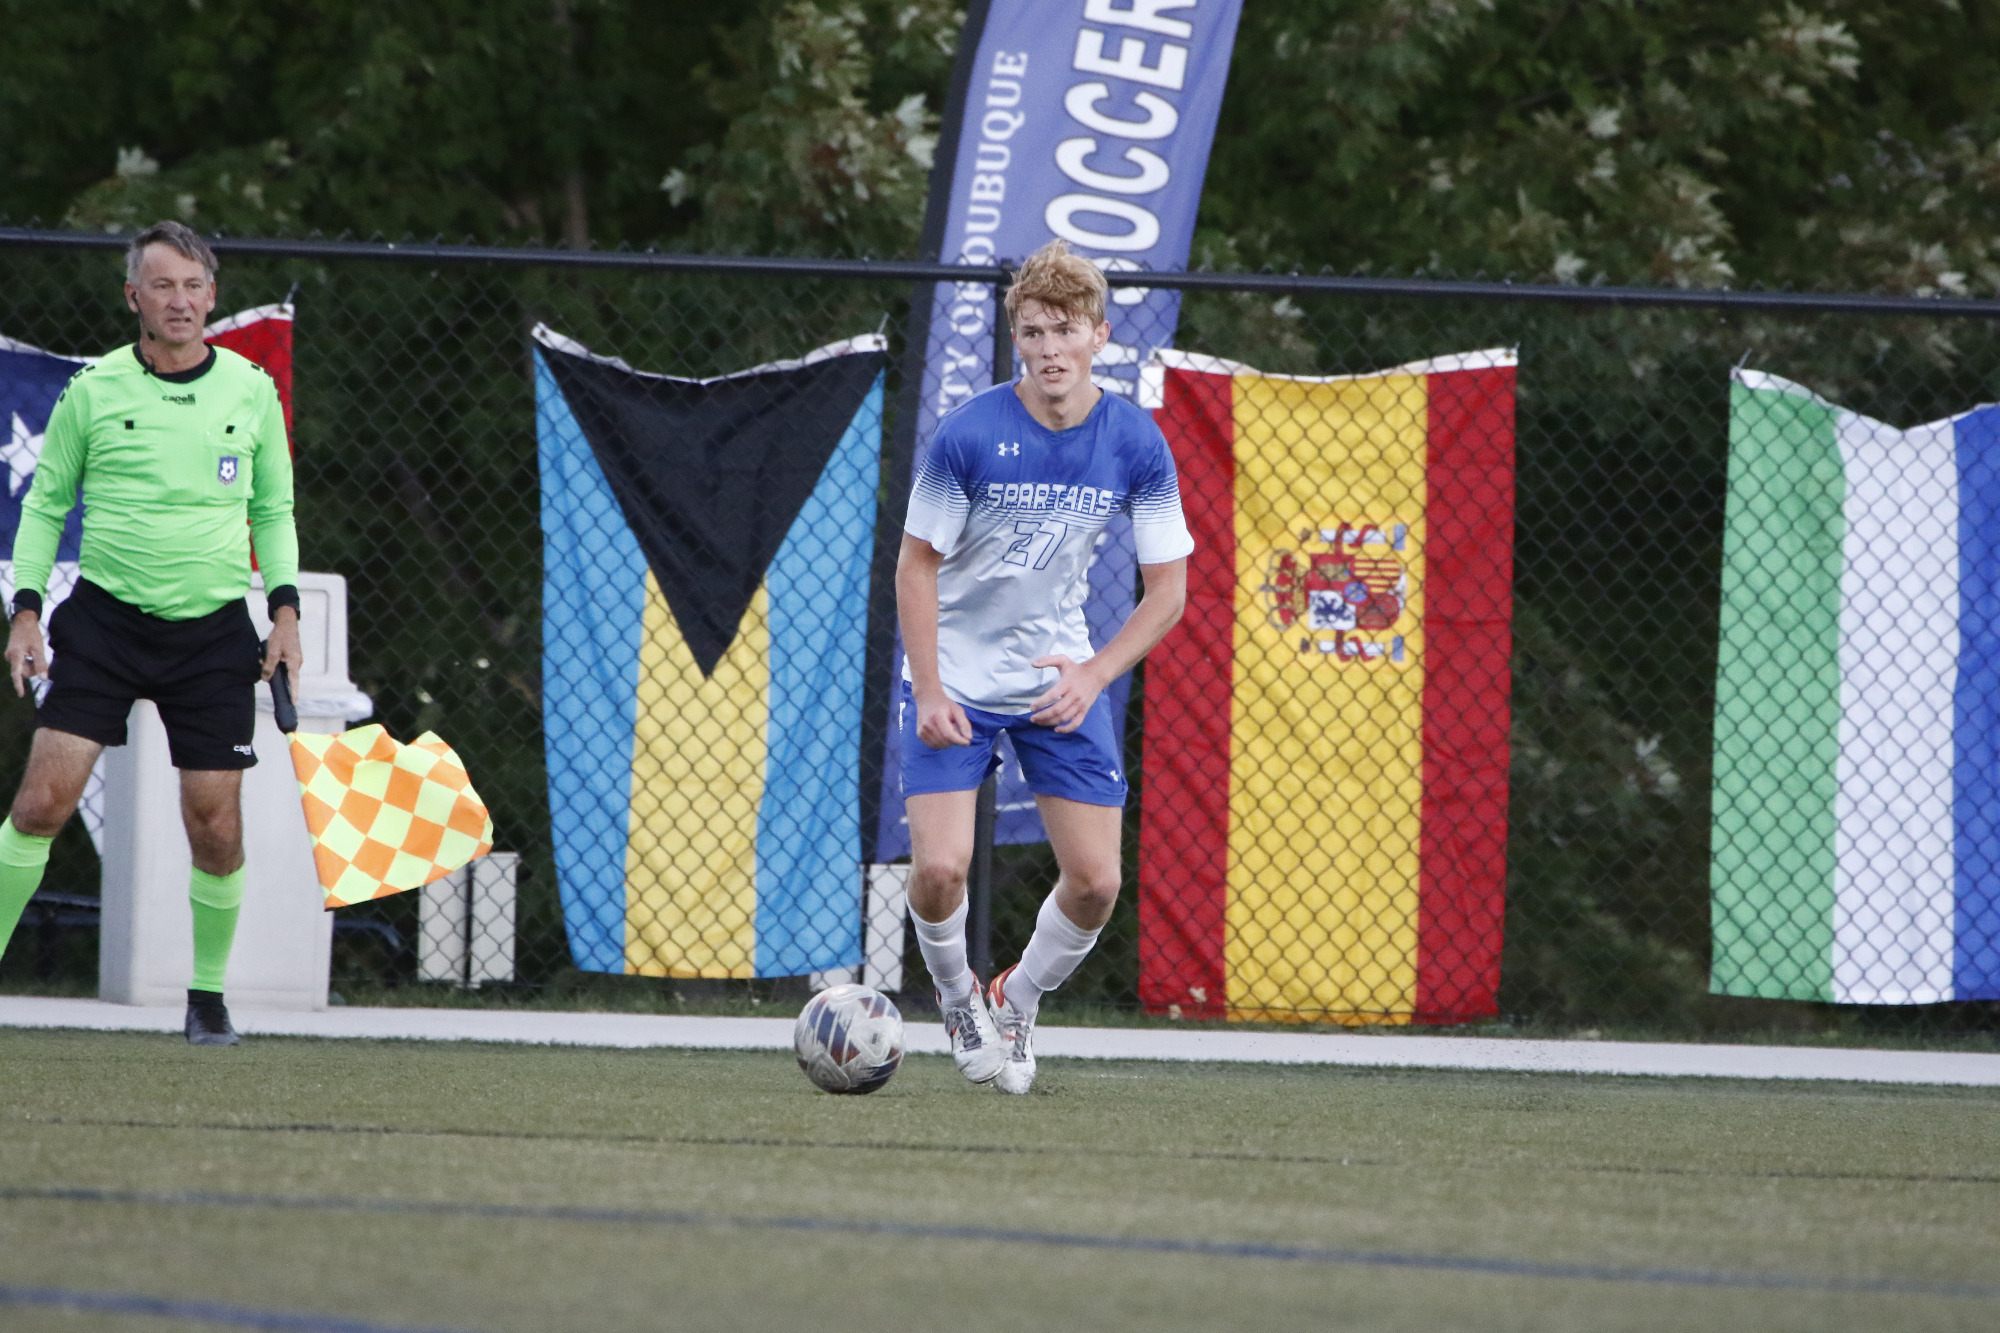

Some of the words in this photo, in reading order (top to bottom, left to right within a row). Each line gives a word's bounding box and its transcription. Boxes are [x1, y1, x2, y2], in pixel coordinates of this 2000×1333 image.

[958, 51, 1028, 266] DUBUQUE
[986, 483, 1113, 515] SPARTANS
[1002, 520, 1068, 570] 27
